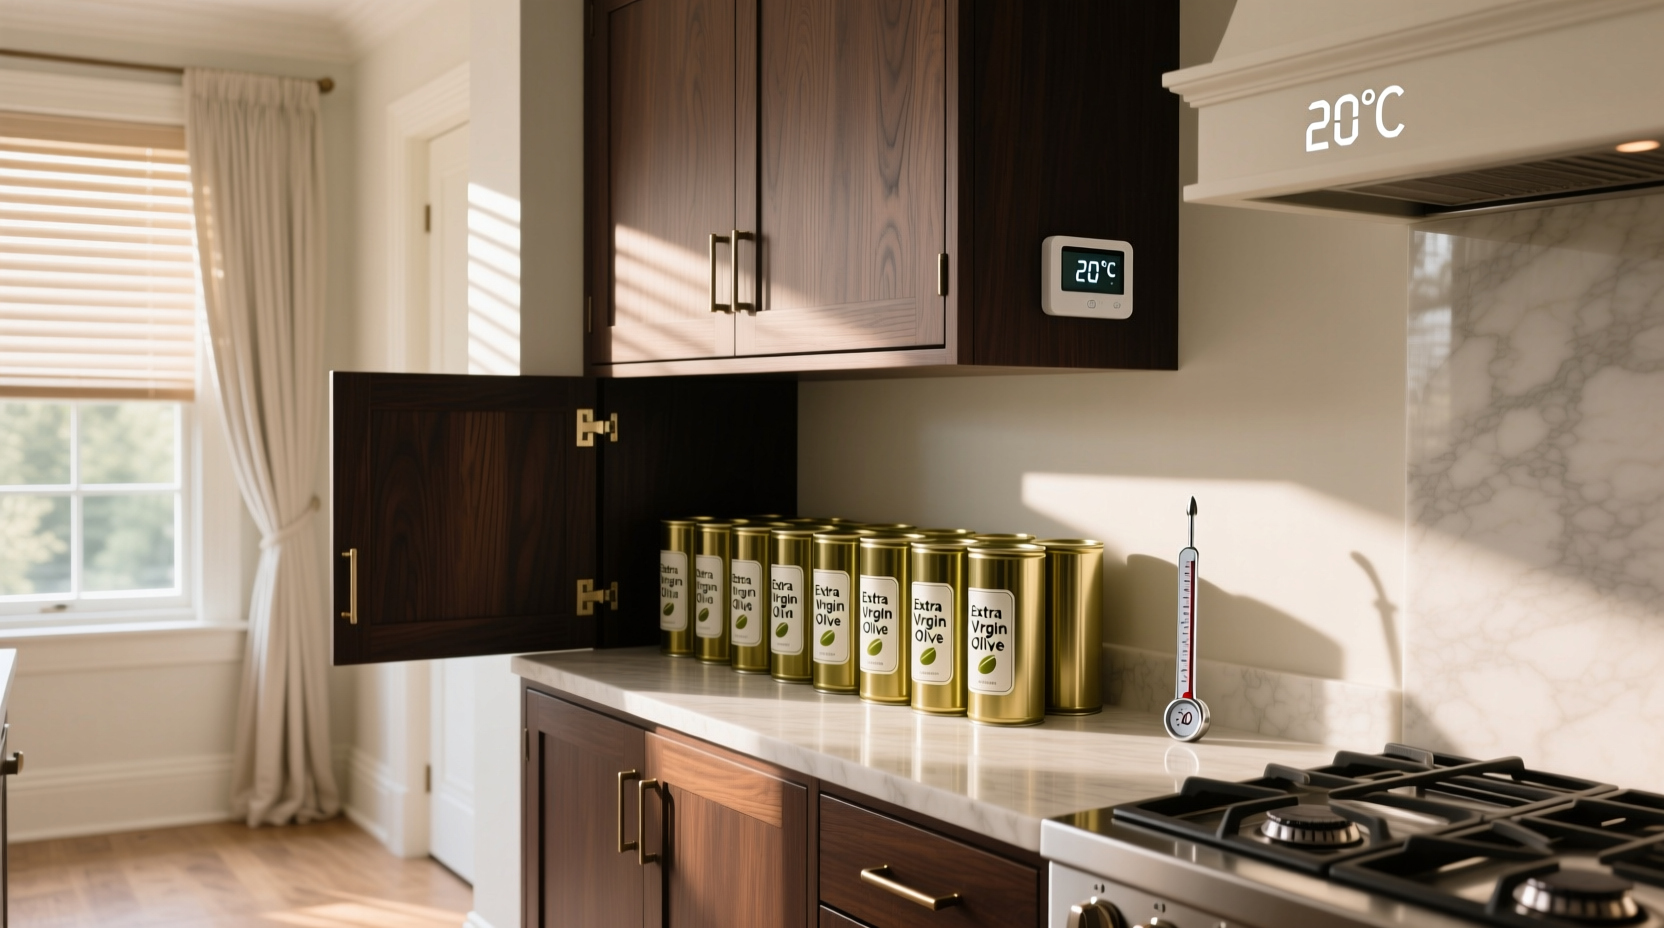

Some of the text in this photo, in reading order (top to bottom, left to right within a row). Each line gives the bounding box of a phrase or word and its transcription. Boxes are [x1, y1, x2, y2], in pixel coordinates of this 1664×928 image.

[1306, 85, 1405, 152] 20°C
[1076, 260, 1116, 283] 20°C
[815, 584, 840, 597] Extra
[862, 591, 888, 605] Extra
[914, 598, 942, 612] Extra
[971, 605, 1002, 619] Extra
[863, 621, 888, 635] Olive
[971, 637, 1005, 652] Olive
